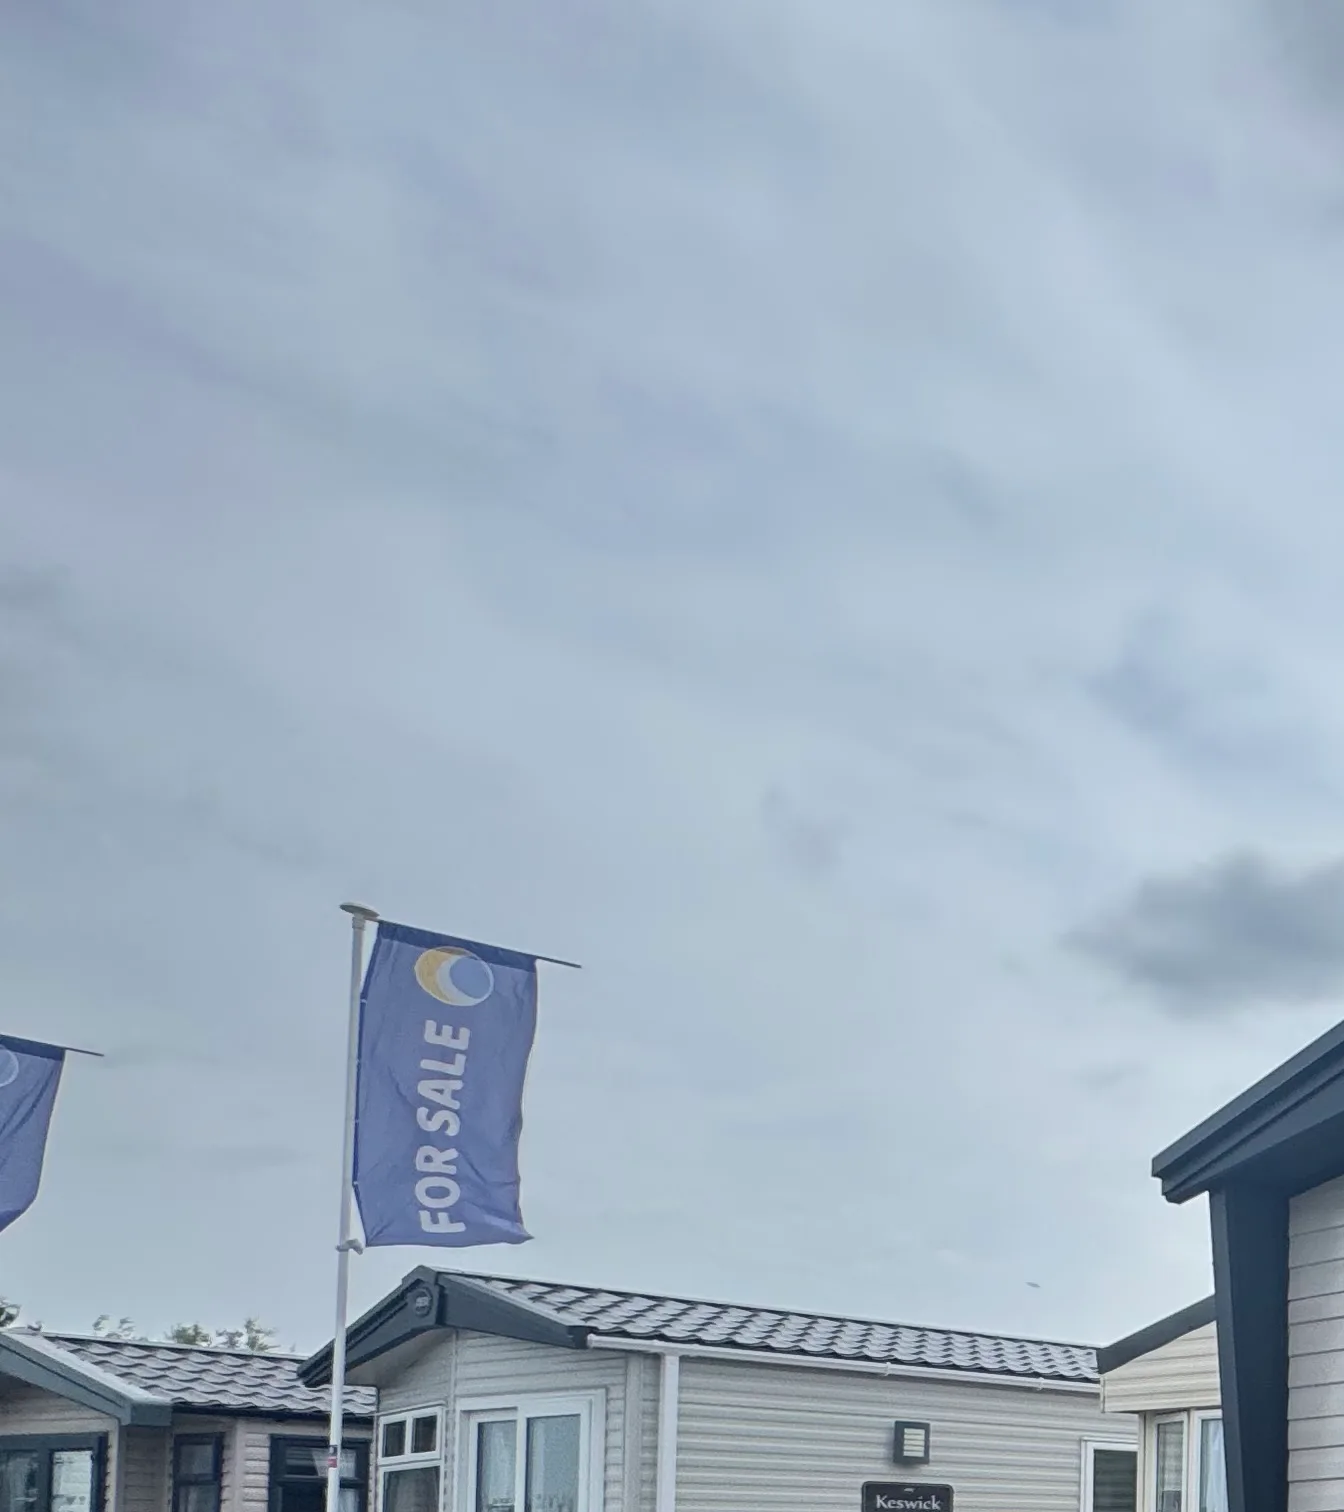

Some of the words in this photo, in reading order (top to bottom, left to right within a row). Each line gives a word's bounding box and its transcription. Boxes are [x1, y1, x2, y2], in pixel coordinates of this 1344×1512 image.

[416, 1019, 471, 1136] SALE
[415, 1145, 466, 1233] FOR
[875, 1494, 941, 1510] Keswick
